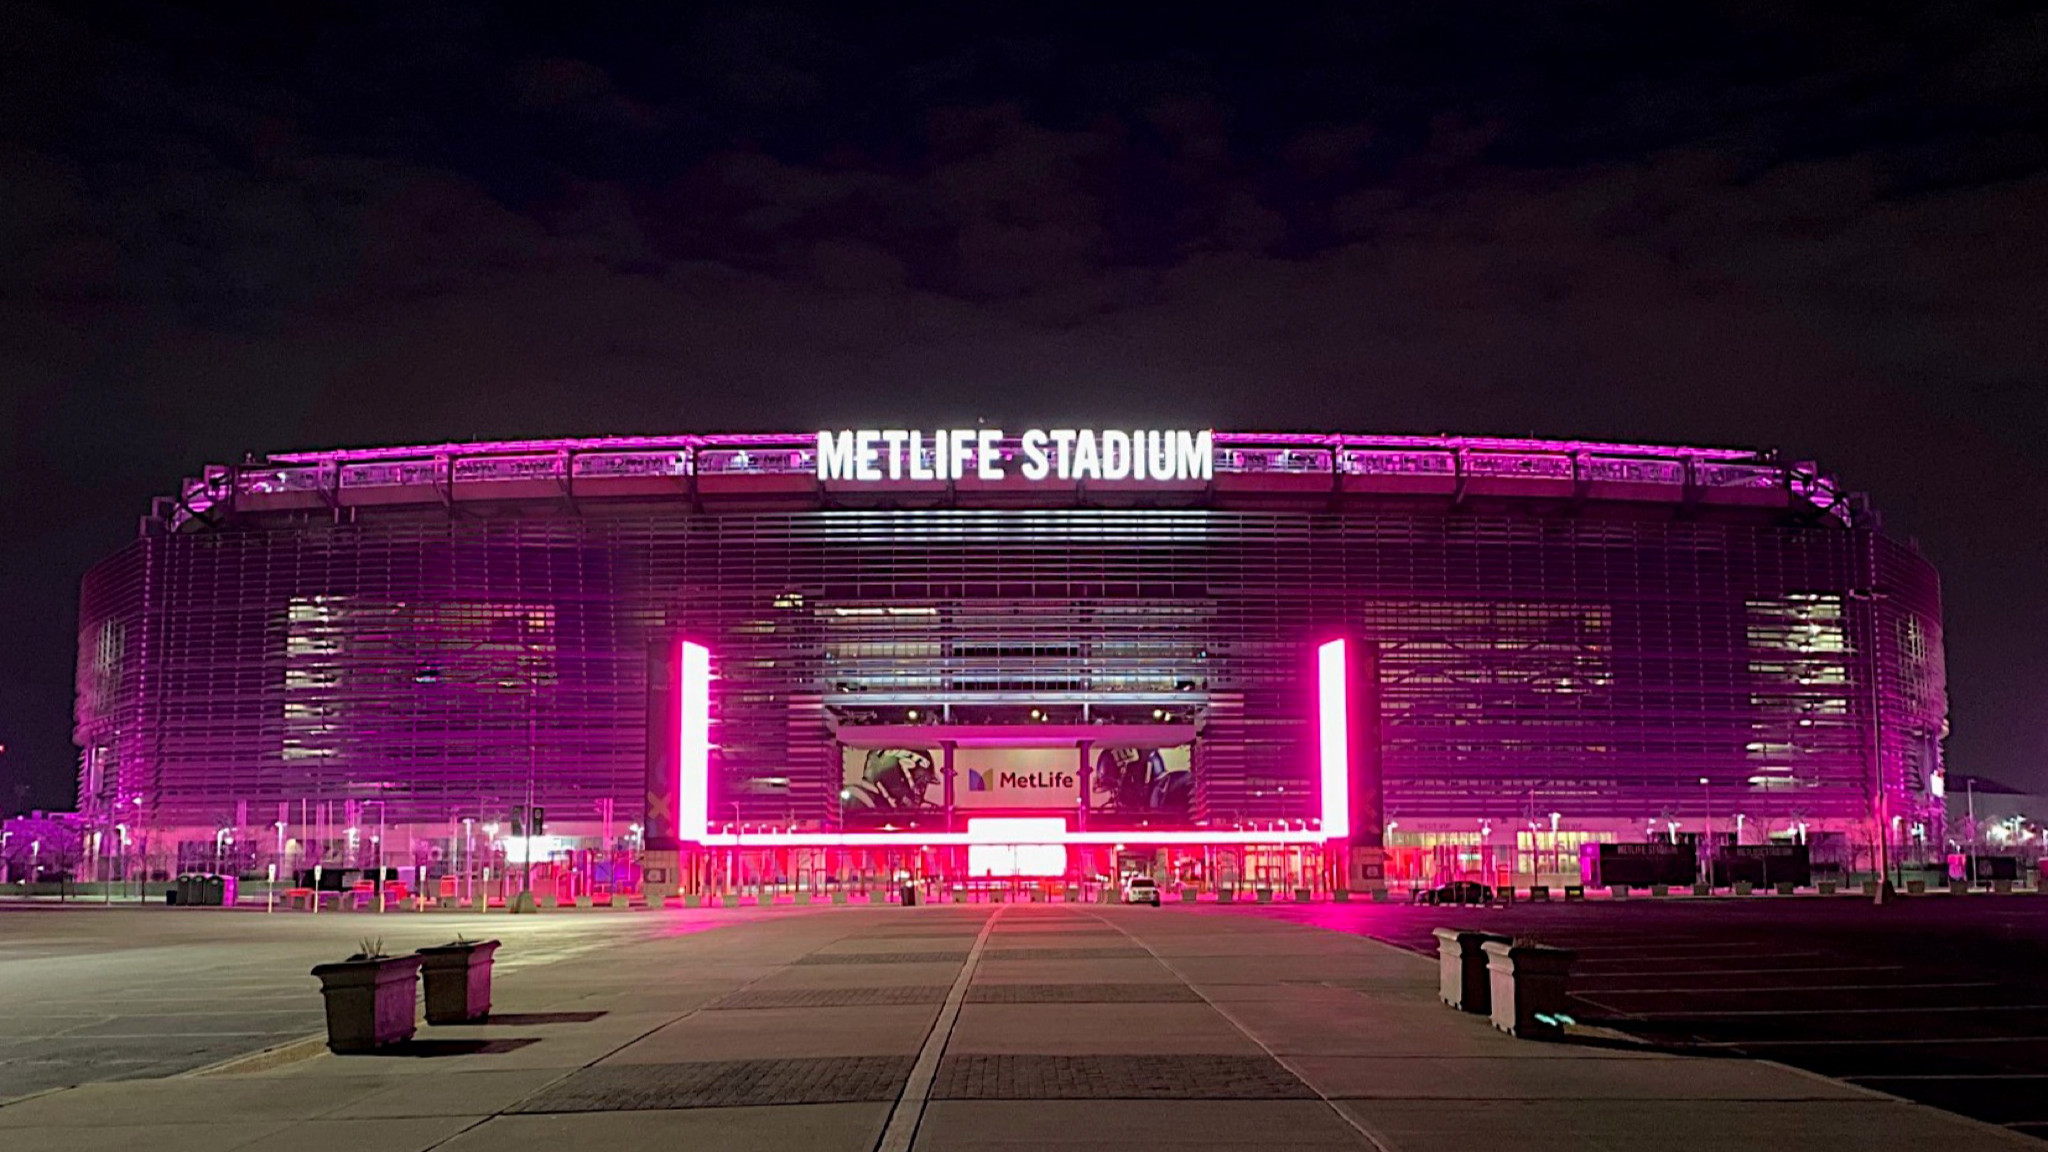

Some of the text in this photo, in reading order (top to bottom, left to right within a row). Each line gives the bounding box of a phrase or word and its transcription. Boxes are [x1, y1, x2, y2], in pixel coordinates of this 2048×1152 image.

[816, 428, 1213, 482] METLIFE STADIUM
[1000, 771, 1073, 789] MetLife
